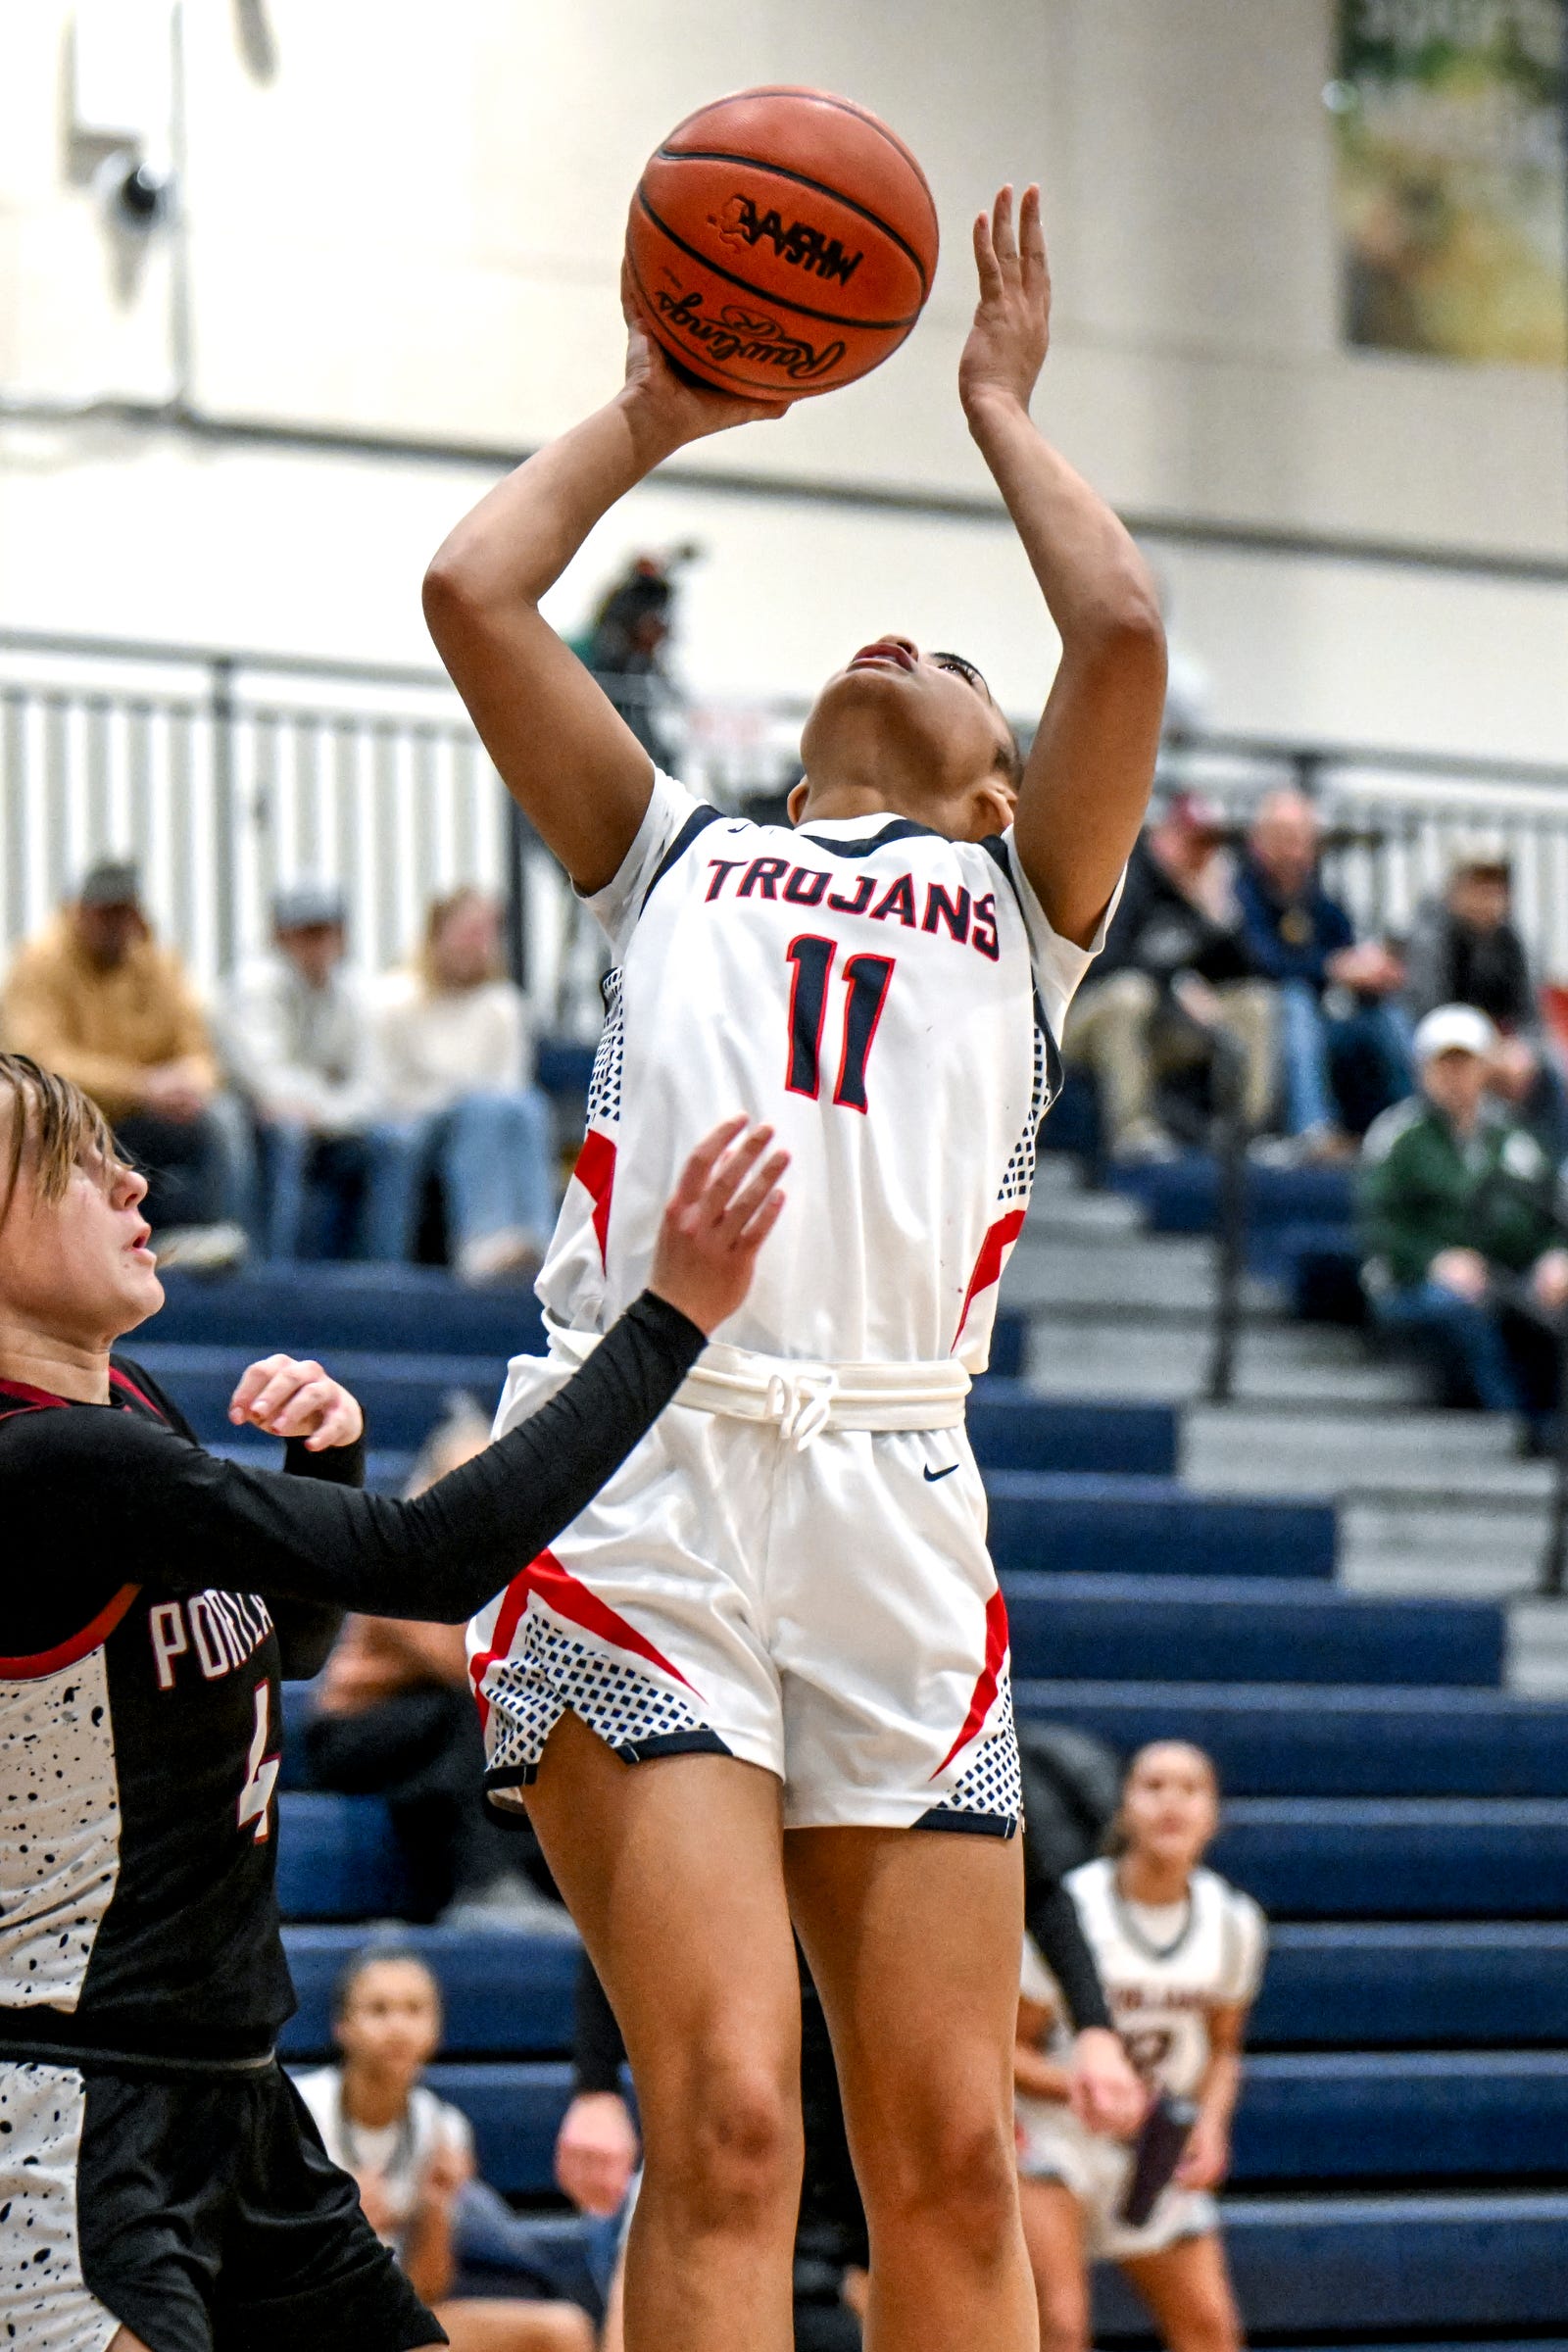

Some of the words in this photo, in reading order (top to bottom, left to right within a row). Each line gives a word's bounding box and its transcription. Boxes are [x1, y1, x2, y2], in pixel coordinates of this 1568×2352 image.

[655, 292, 846, 378] Rawlings
[705, 857, 1000, 961] TROJANS
[785, 933, 897, 1114] 11
[237, 1679, 281, 1844] 4
